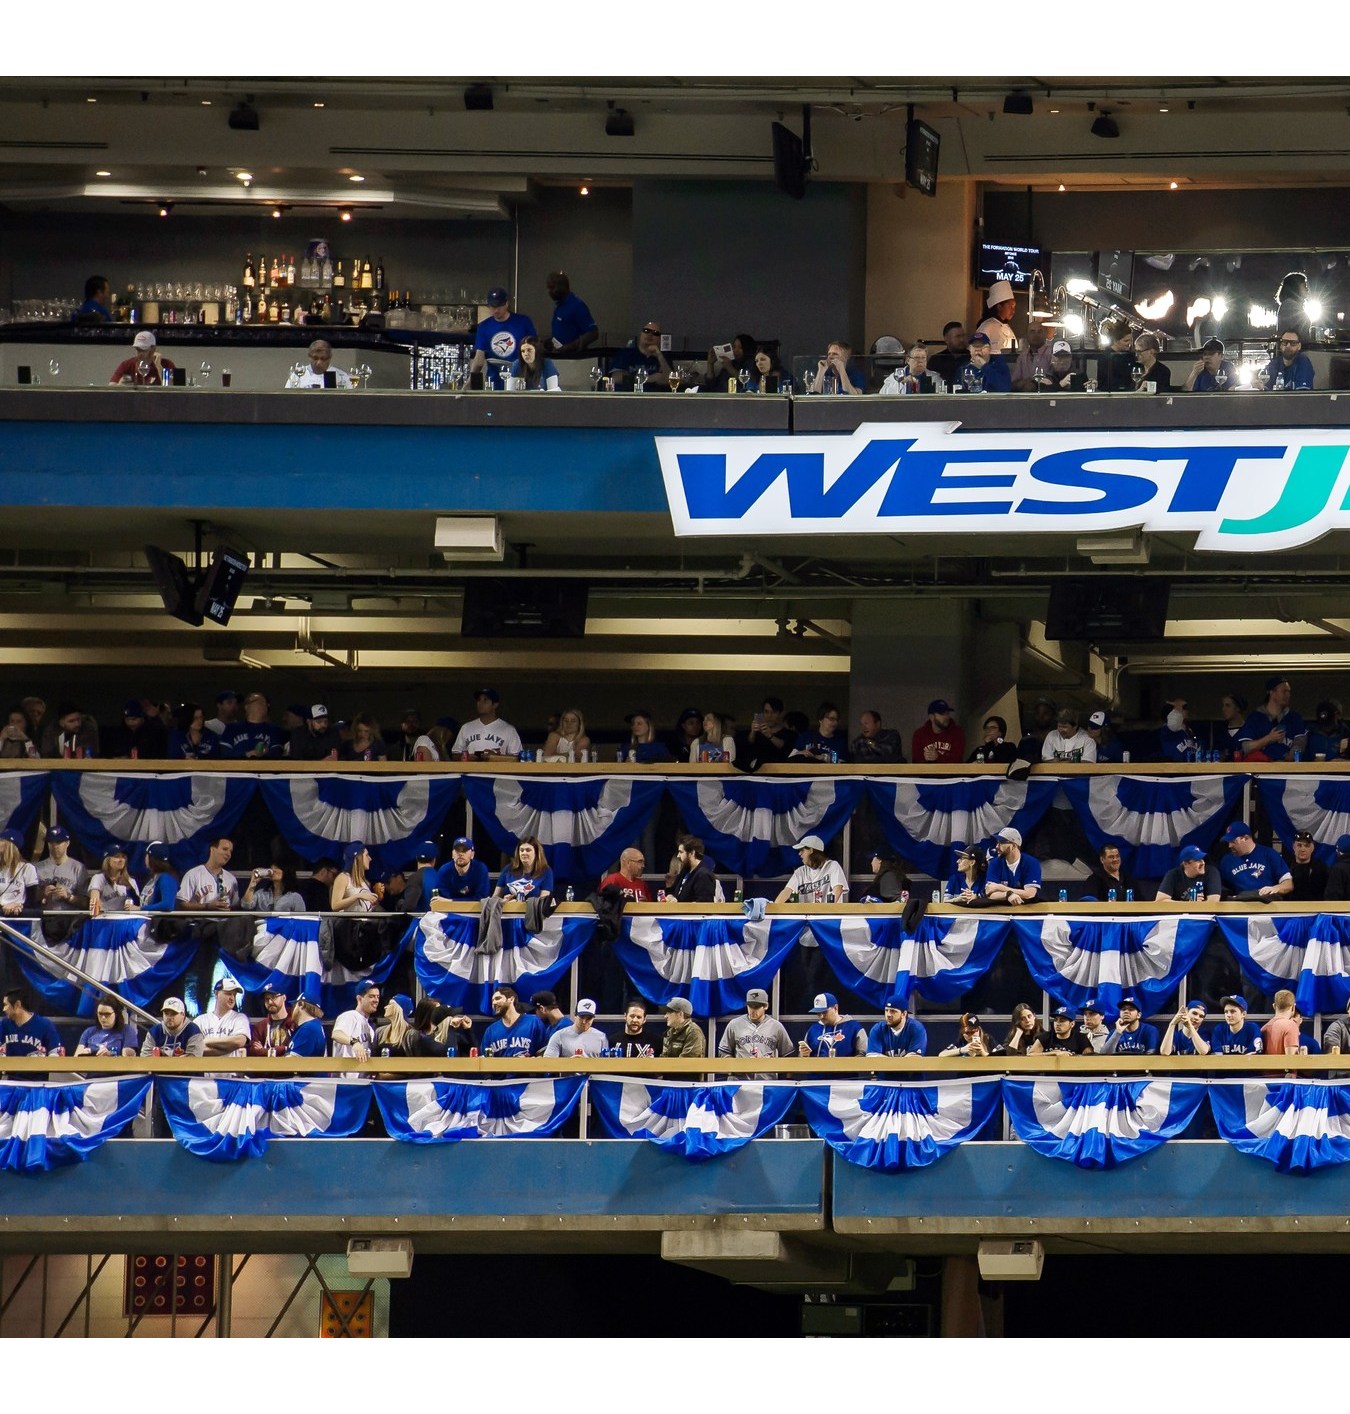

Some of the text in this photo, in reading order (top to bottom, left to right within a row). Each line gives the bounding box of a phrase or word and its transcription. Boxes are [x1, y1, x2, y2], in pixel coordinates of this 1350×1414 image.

[996, 272, 1024, 282] MAY 25
[485, 734, 505, 747] JAYS
[1231, 862, 1266, 876] BLUE JAYS
[5, 1033, 42, 1048] LUE JAY
[510, 1036, 532, 1049] JAYS
[1231, 1044, 1248, 1054] JAY
